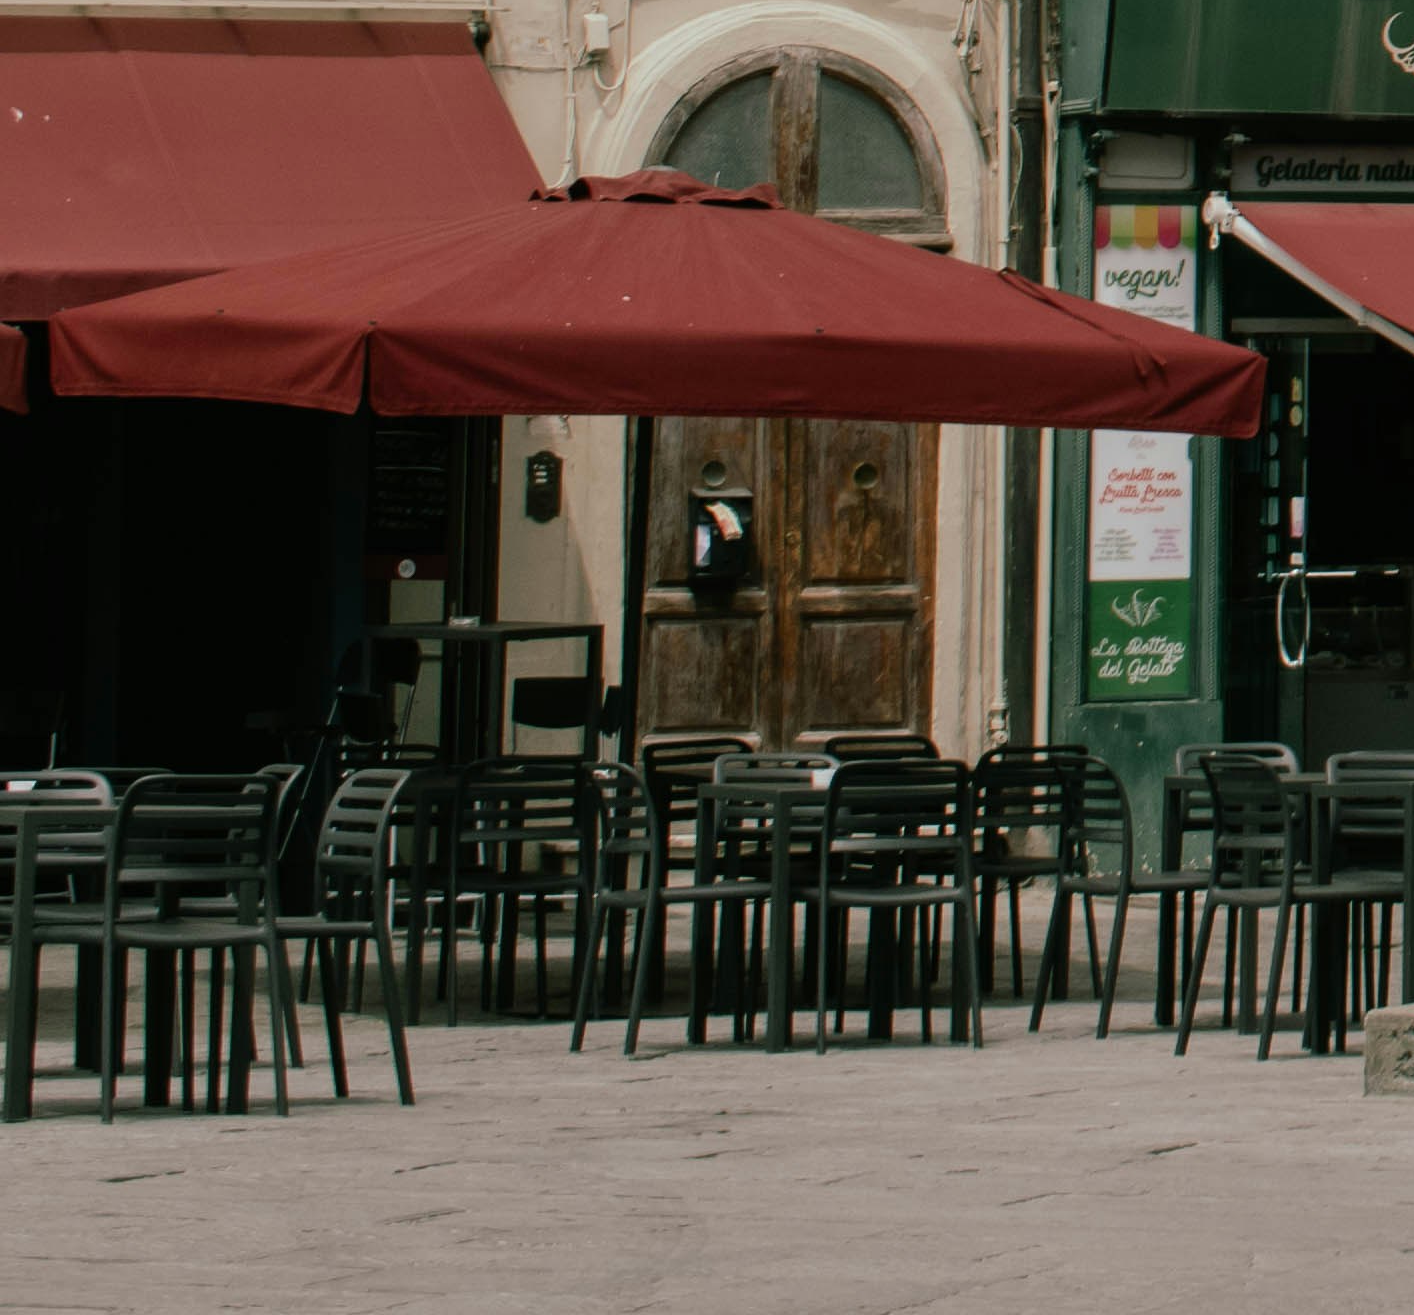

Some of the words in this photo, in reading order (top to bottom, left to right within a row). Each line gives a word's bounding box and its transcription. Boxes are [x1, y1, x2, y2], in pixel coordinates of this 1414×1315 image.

[1255, 155, 1362, 188] Gelateria
[1104, 258, 1185, 299] vegan!
[1091, 637, 1121, 657] La
[1124, 636, 1186, 663] Bottega
[1098, 658, 1124, 678] del
[1127, 658, 1177, 685] Gelato
